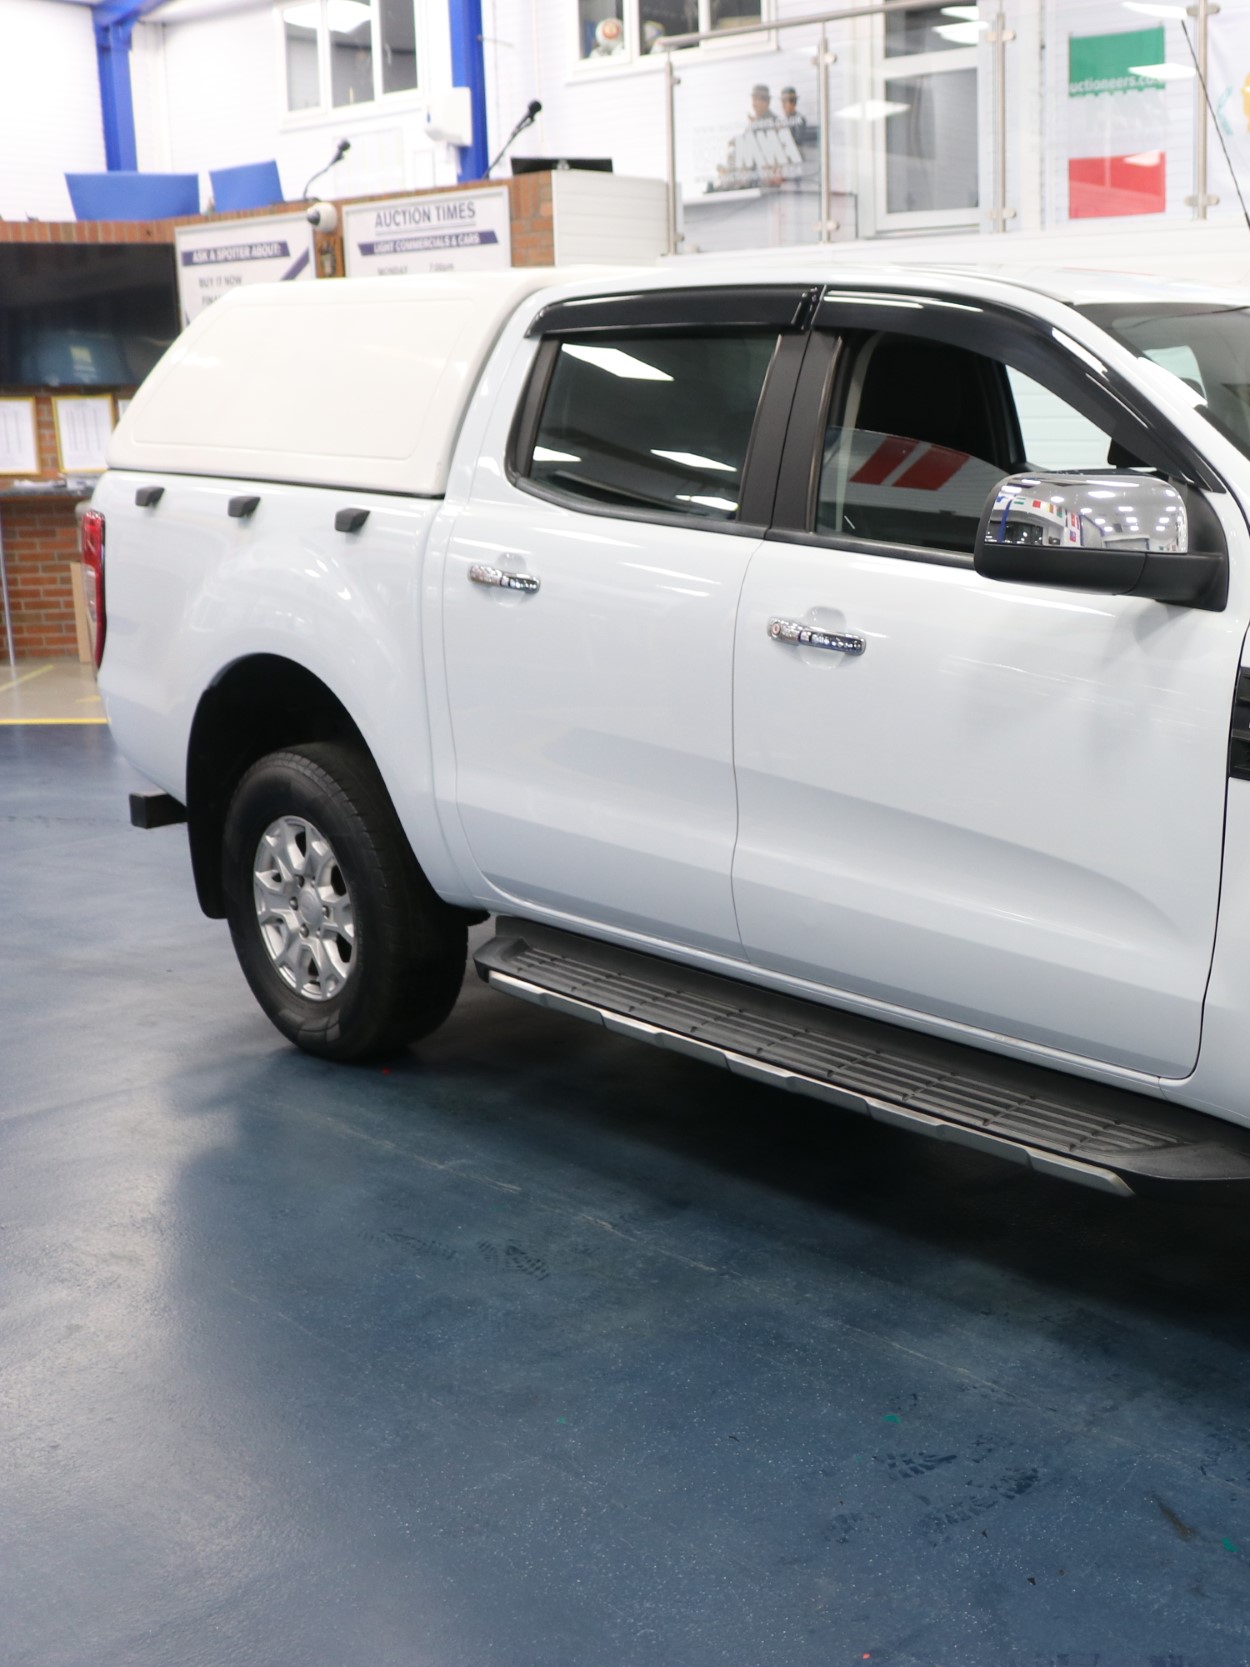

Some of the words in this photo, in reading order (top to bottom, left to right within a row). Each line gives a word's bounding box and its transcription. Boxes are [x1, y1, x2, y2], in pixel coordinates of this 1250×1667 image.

[375, 207, 431, 228] AUCTION
[434, 201, 476, 222] TIMES
[193, 250, 209, 263] ASK
[216, 246, 250, 261] SPOTTER
[224, 275, 242, 286] NOW
